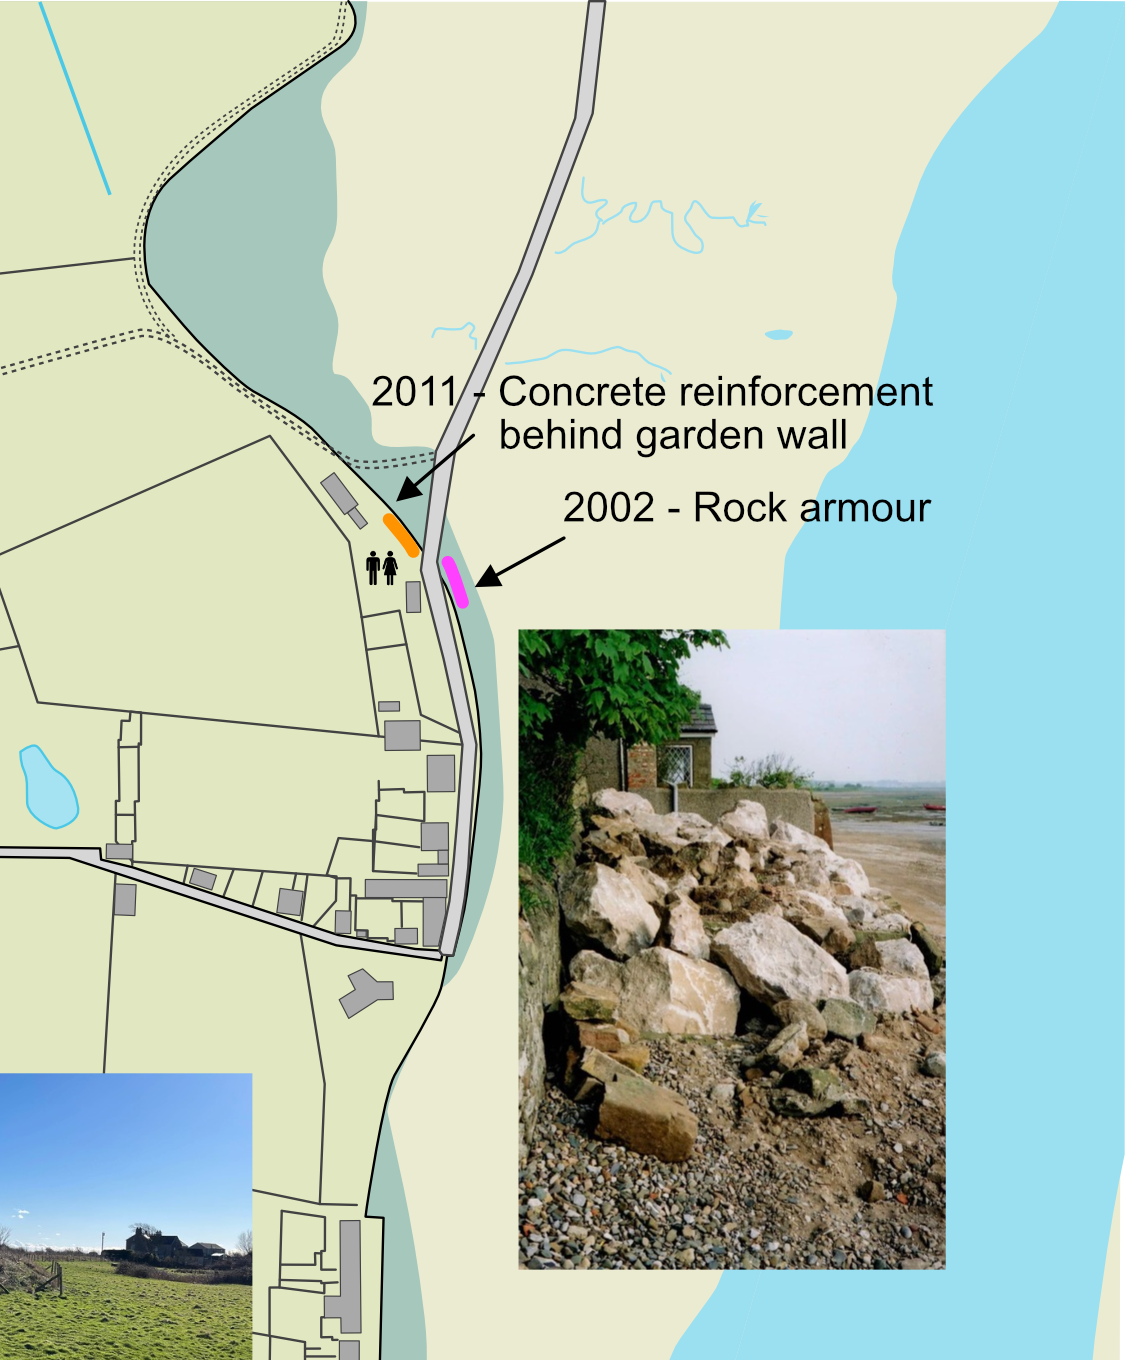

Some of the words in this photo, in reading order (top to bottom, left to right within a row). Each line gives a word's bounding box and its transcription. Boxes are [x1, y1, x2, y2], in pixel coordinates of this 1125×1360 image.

[372, 375, 455, 407] 2011
[498, 375, 666, 407] Concrete
[681, 375, 934, 407] reinforcement
[501, 418, 621, 450] behind
[636, 418, 763, 458] garden
[776, 418, 846, 450] wall
[563, 491, 654, 523] 2002
[695, 491, 787, 523] Rock
[800, 499, 932, 523] armour
